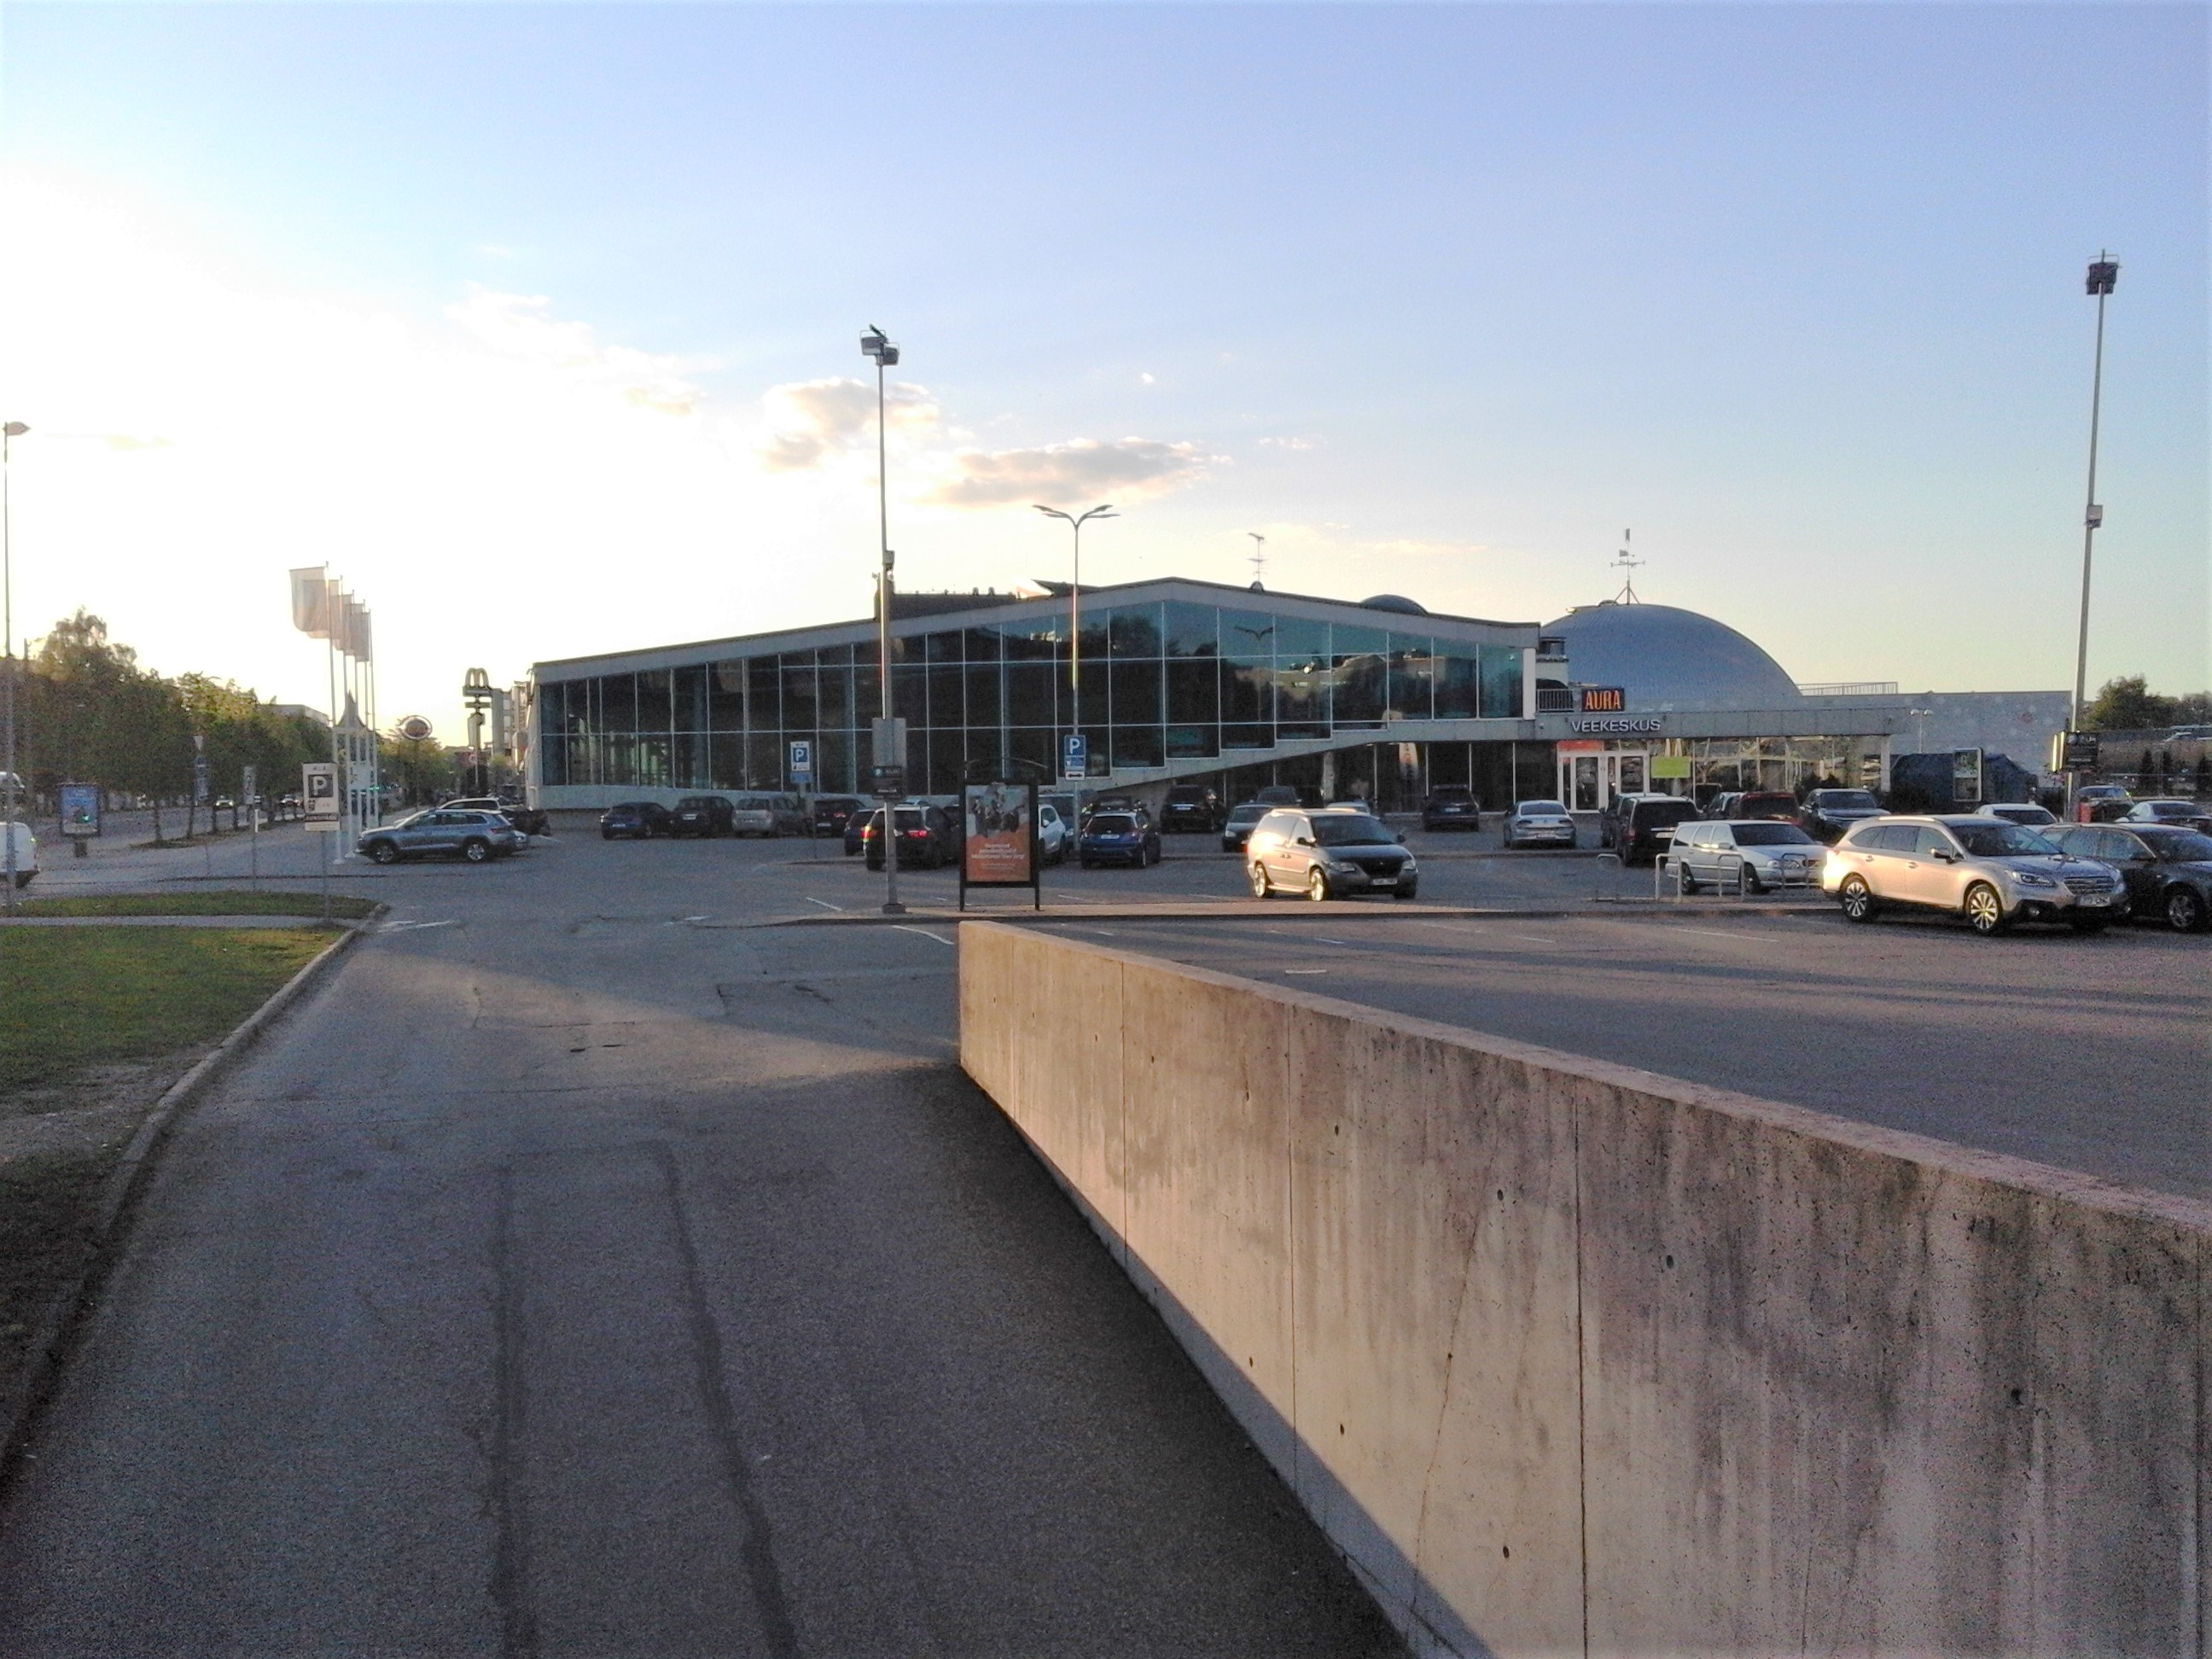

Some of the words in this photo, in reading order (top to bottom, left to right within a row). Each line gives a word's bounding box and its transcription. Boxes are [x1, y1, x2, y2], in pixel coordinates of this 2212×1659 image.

[1585, 690, 1621, 710] AURA
[1571, 719, 1661, 732] VEEKESKUS
[1069, 737, 1080, 754] P
[795, 748, 805, 761] P
[312, 775, 328, 795] P
